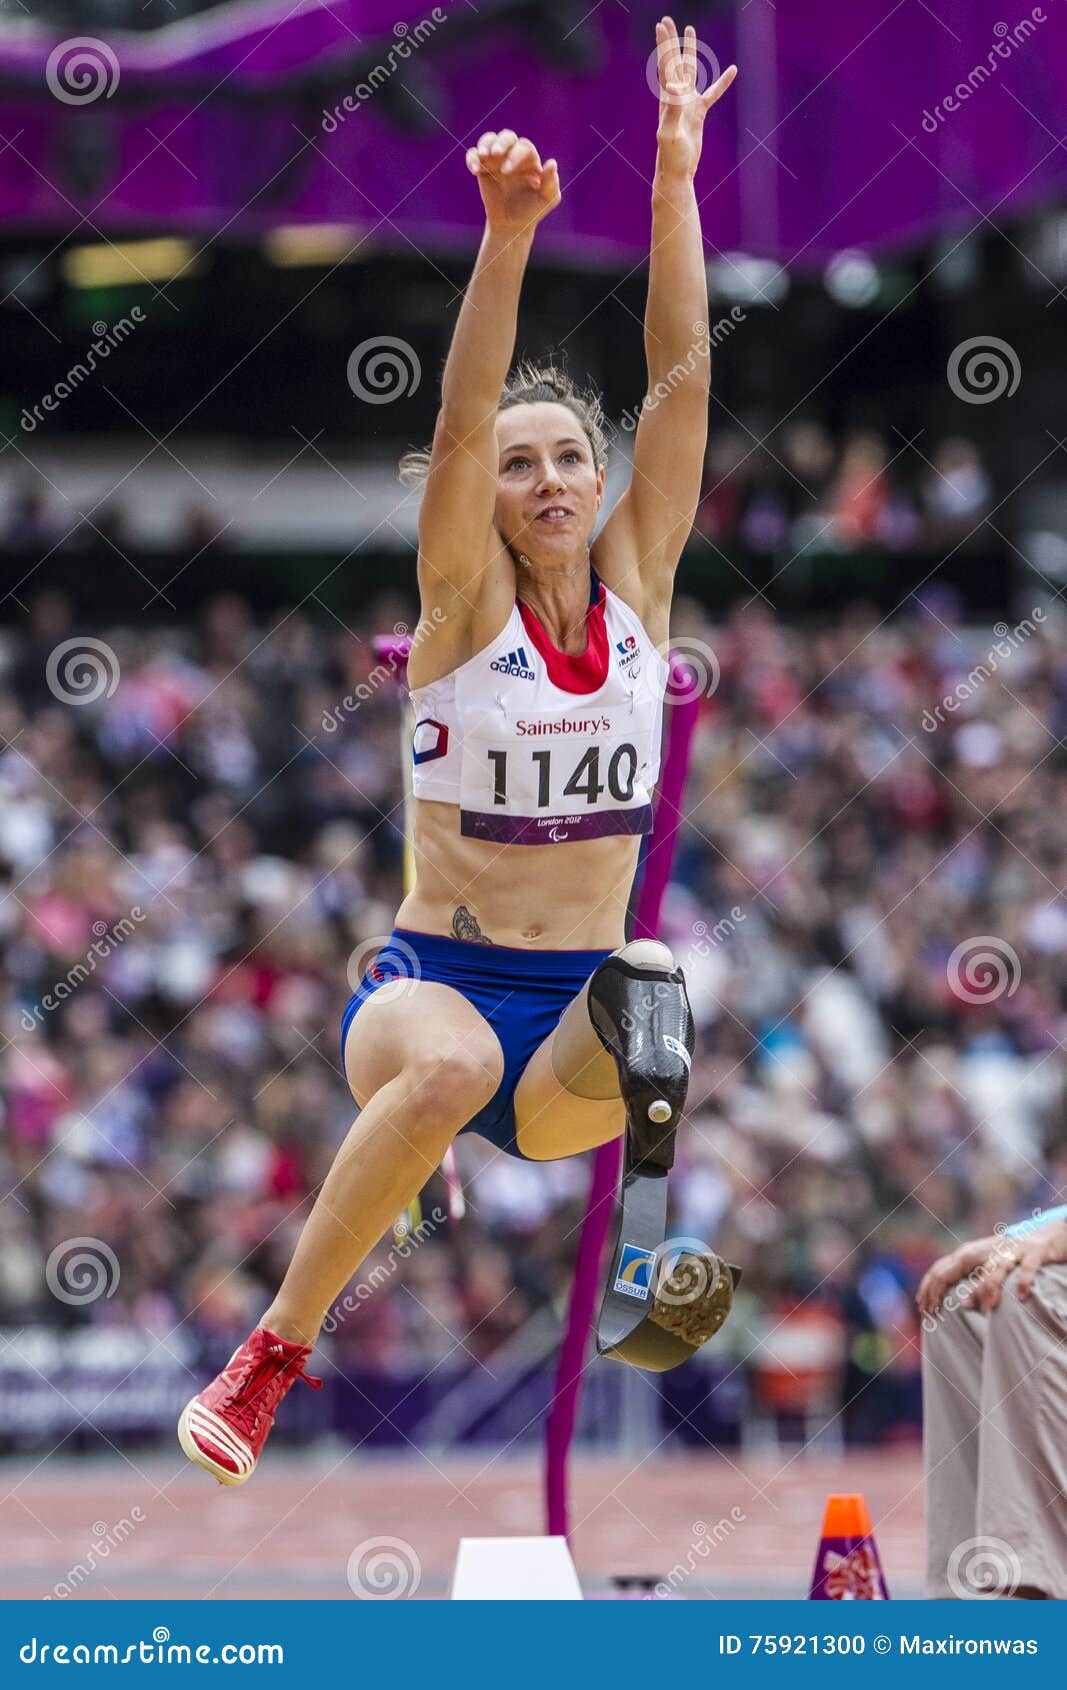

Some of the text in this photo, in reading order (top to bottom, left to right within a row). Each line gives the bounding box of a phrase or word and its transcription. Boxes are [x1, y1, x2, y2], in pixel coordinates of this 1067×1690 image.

[490, 660, 536, 681] adidas
[515, 716, 611, 736] Sainsbury's
[487, 743, 638, 808] 1140
[537, 815, 582, 827] London 2012
